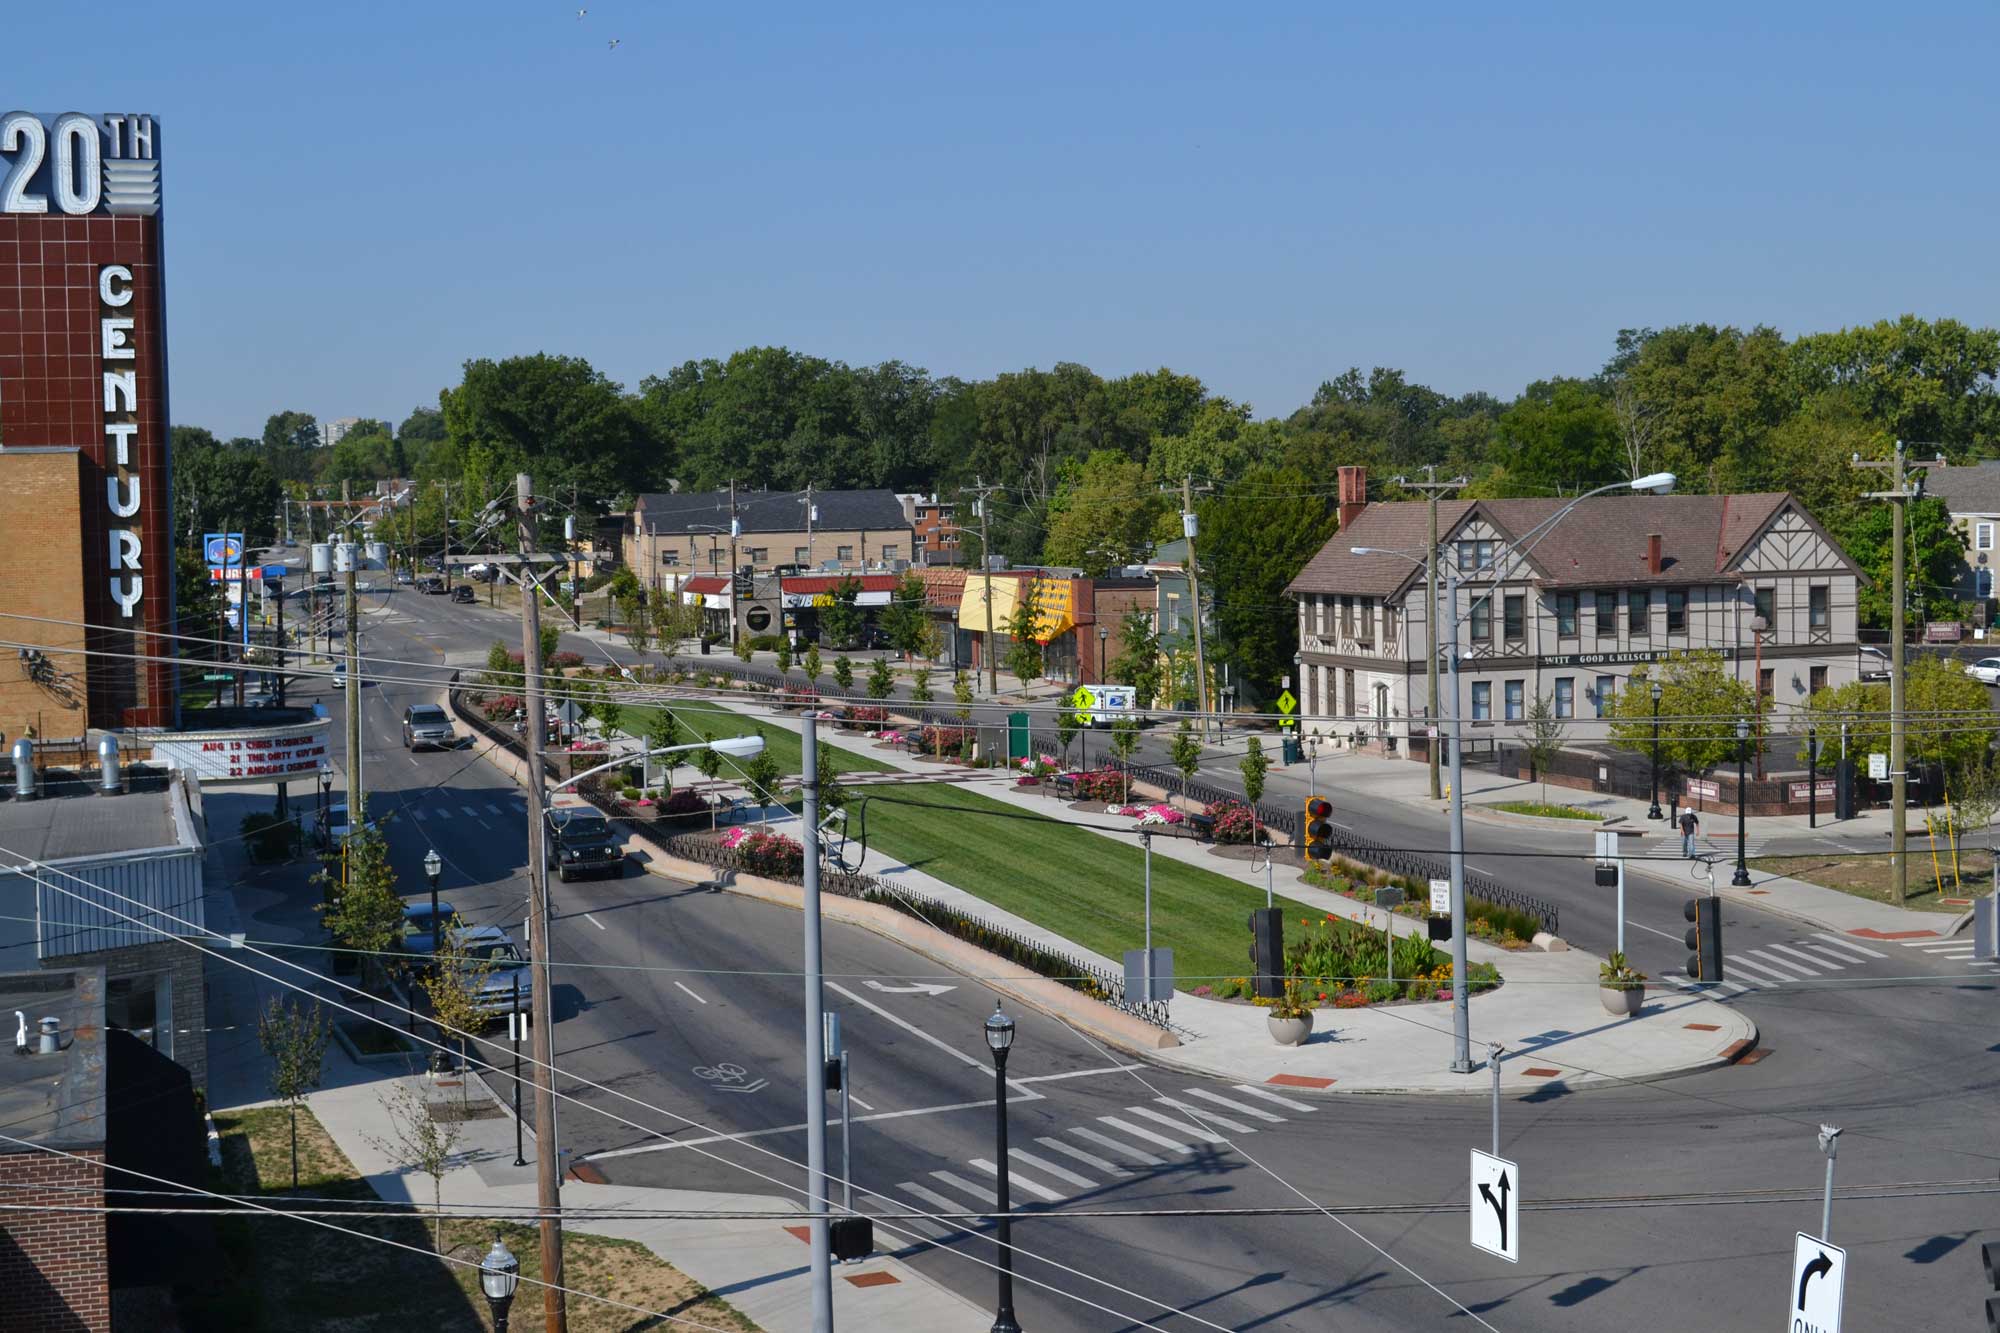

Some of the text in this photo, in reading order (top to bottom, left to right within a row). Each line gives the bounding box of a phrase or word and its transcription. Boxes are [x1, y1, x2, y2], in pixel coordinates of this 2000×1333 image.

[99, 264, 143, 617] CENTURY
[1545, 656, 1570, 664] WITT
[1579, 655, 1604, 663] GOOD
[1617, 652, 1650, 662] KELSCH
[202, 742, 225, 752] AUG
[230, 742, 242, 751] 19
[246, 740, 272, 750] CHRIS
[230, 755, 240, 763] 21
[247, 753, 265, 762] THE
[268, 751, 291, 760] DIRTY
[229, 767, 242, 776] 22
[247, 765, 284, 775] ANDERS
[1794, 1318, 1827, 1333] ON
